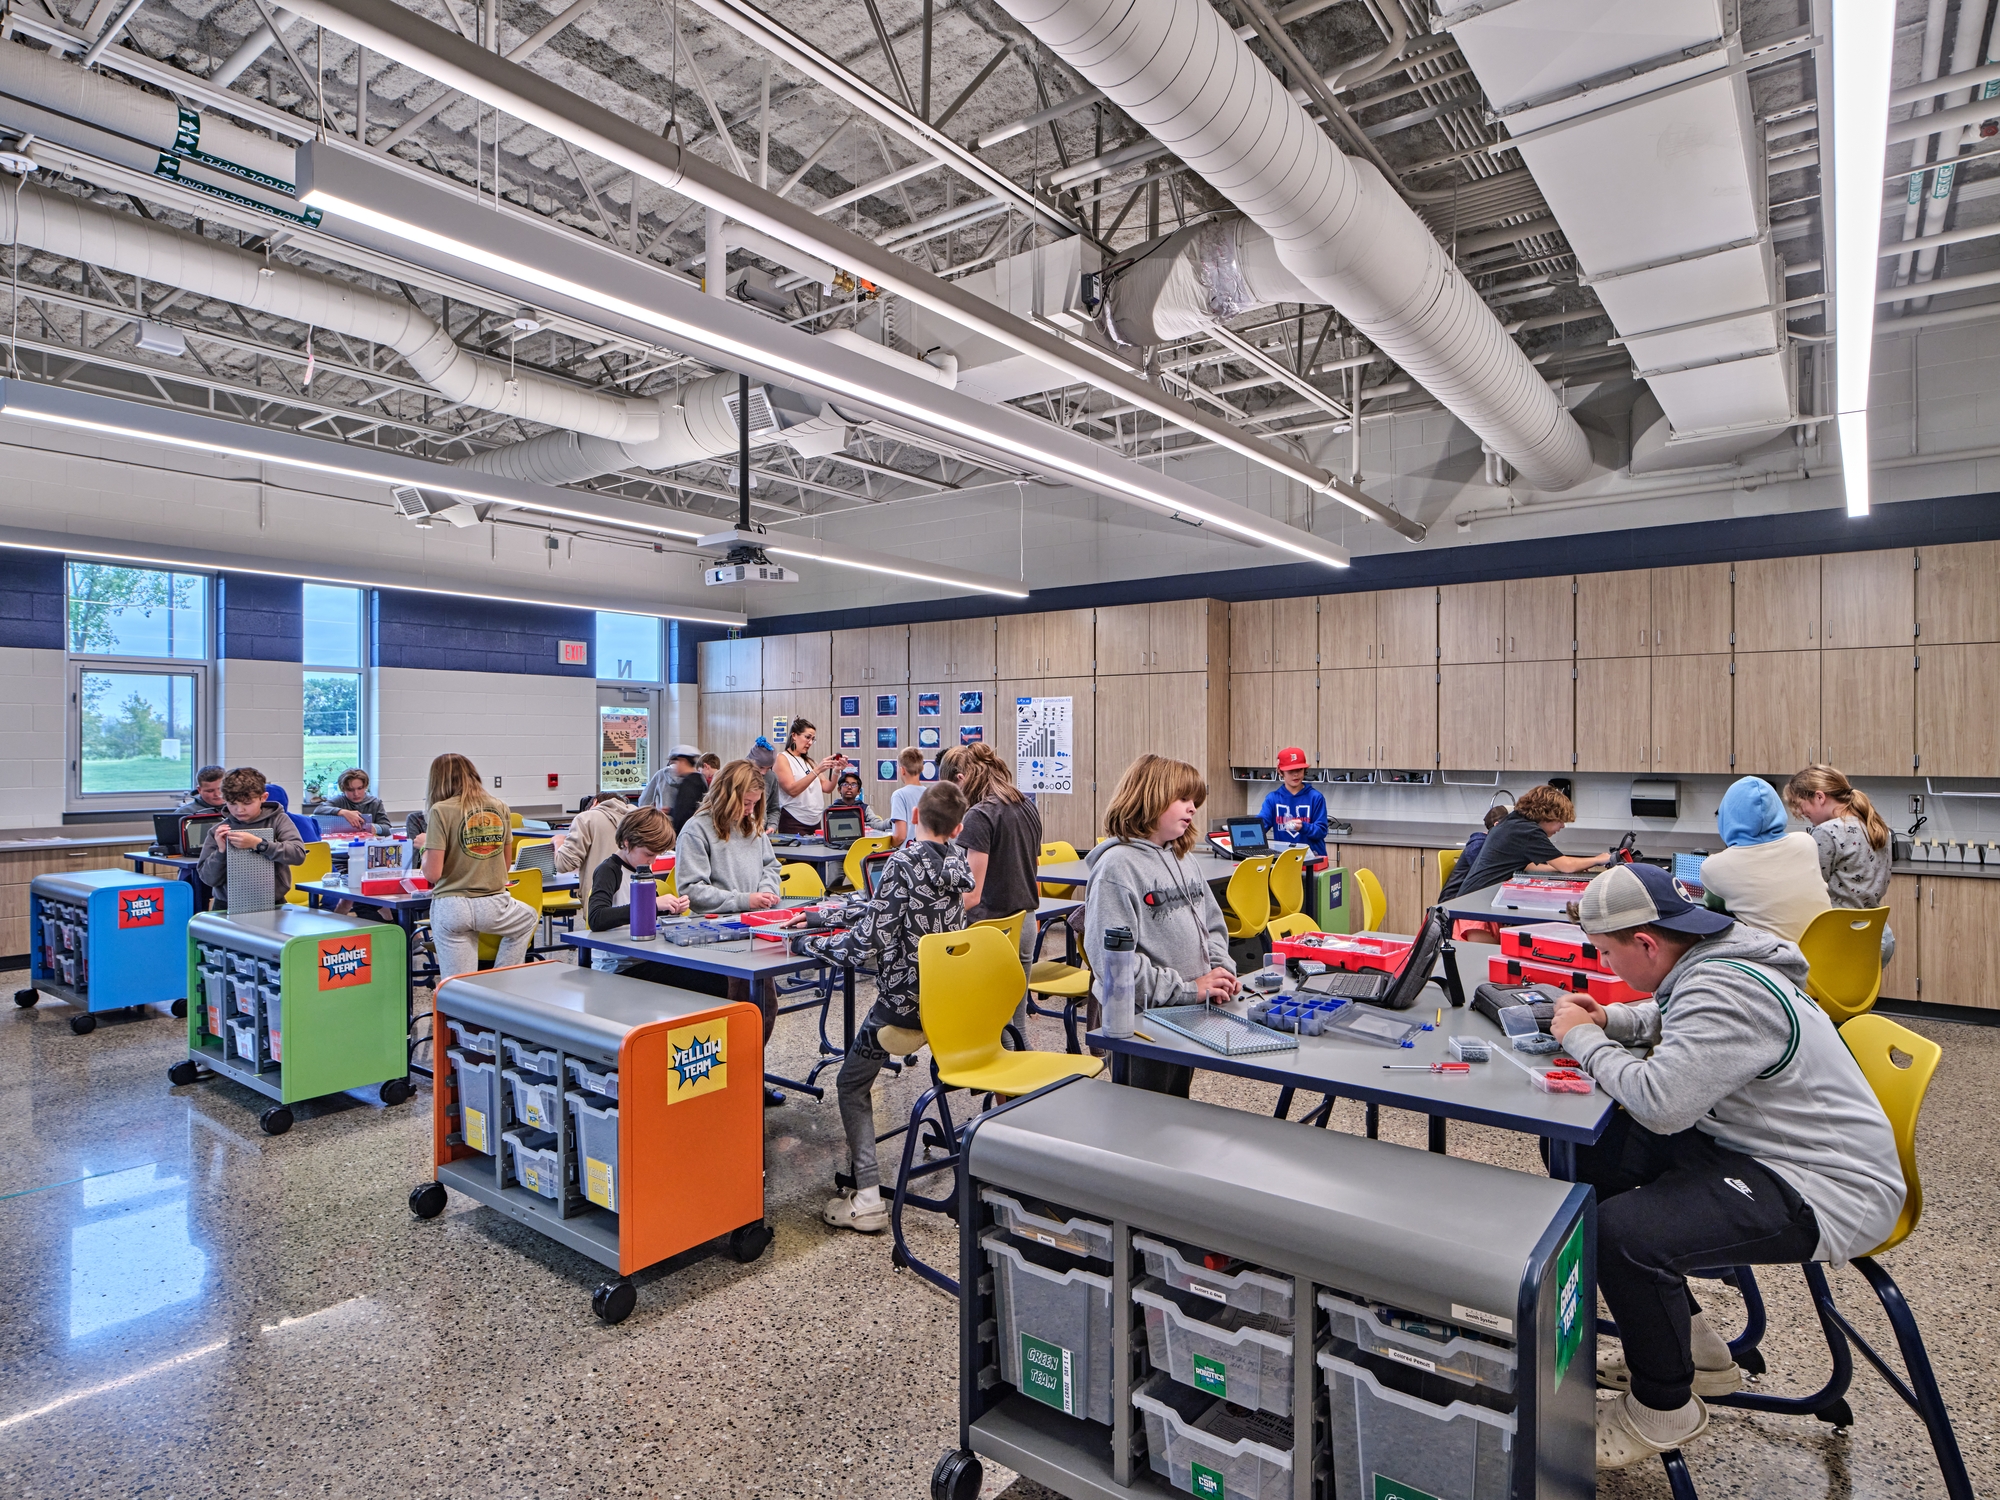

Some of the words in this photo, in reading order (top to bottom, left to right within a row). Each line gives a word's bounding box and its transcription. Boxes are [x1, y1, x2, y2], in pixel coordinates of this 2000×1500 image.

[202, 155, 246, 177] SUPPLY
[565, 644, 583, 661] EXIT
[131, 908, 152, 917] TEAM
[132, 899, 150, 909] RED
[322, 948, 367, 966] ORANGE
[333, 962, 358, 974] TEAM
[673, 1038, 721, 1067] YELLOW
[684, 1058, 711, 1078] TEAM
[1732, 1178, 1753, 1195] NIKE
[1561, 1258, 1579, 1318] GREEN
[1465, 1312, 1479, 1320] Smith
[1563, 1292, 1577, 1336] TEAM
[1027, 1347, 1059, 1371] GREEN
[1393, 1352, 1413, 1363] Colored
[1413, 1358, 1431, 1368] Pencils
[1030, 1368, 1057, 1390] TEAM
[1195, 1367, 1224, 1382] ROBOTICS
[1250, 1415, 1275, 1428] STEAM
[1258, 1411, 1279, 1422] MEET
[1280, 1419, 1293, 1428] THE
[1198, 1476, 1217, 1491] CSIM
